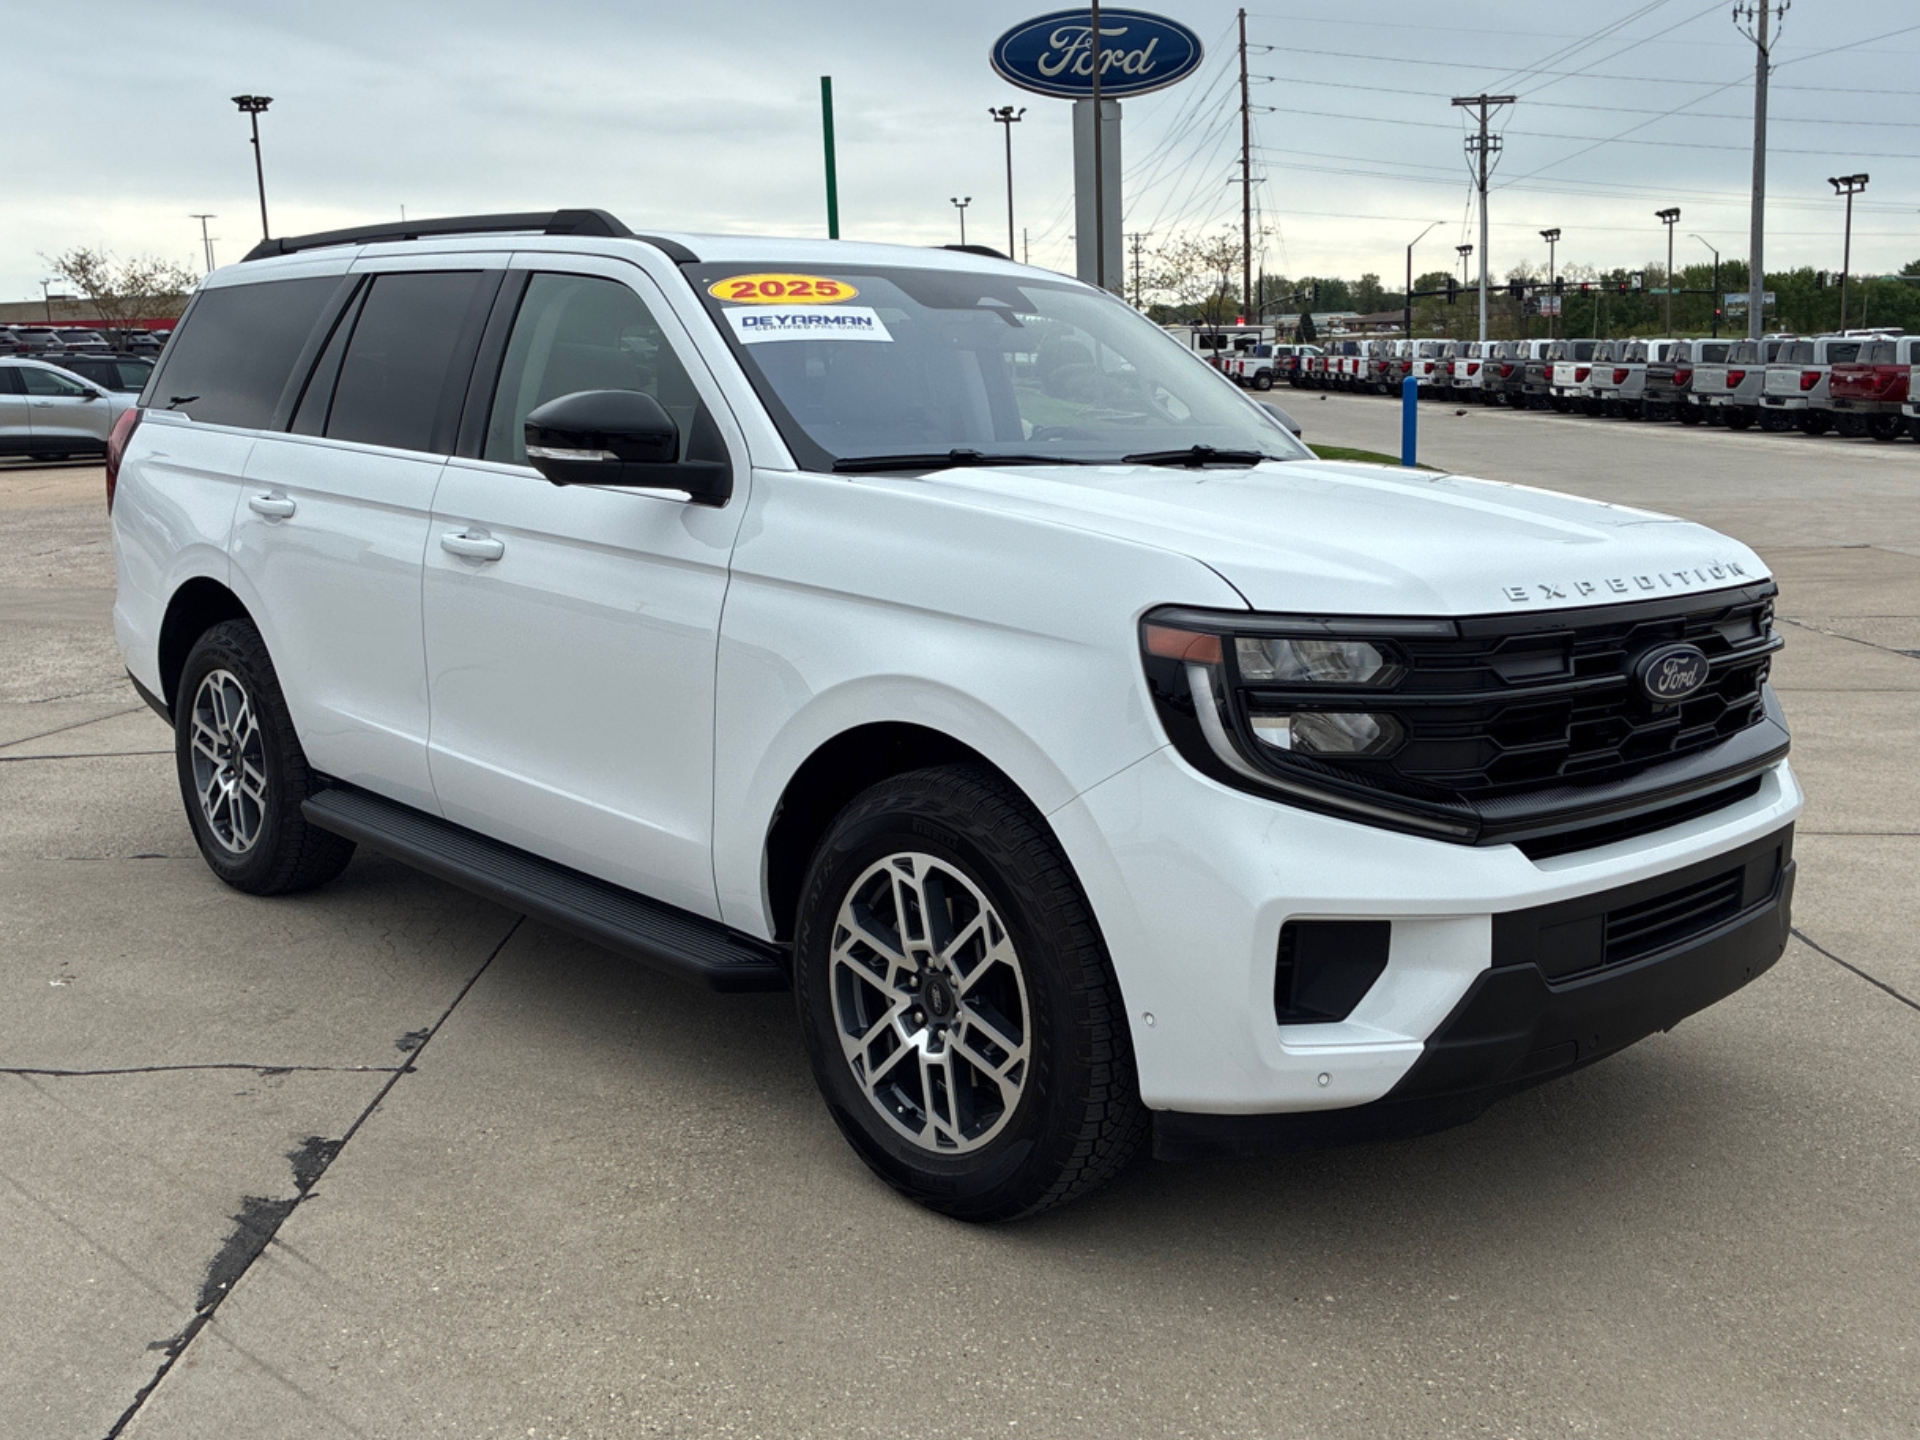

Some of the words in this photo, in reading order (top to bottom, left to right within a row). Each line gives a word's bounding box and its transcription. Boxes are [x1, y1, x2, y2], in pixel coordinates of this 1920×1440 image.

[1037, 26, 1159, 77] Ford
[730, 280, 841, 298] 2025
[742, 314, 873, 327] DEYARMAN
[814, 323, 875, 331] PRE-OWNED
[1502, 559, 1748, 602] EXPEDITION
[1658, 656, 1700, 692] Ford
